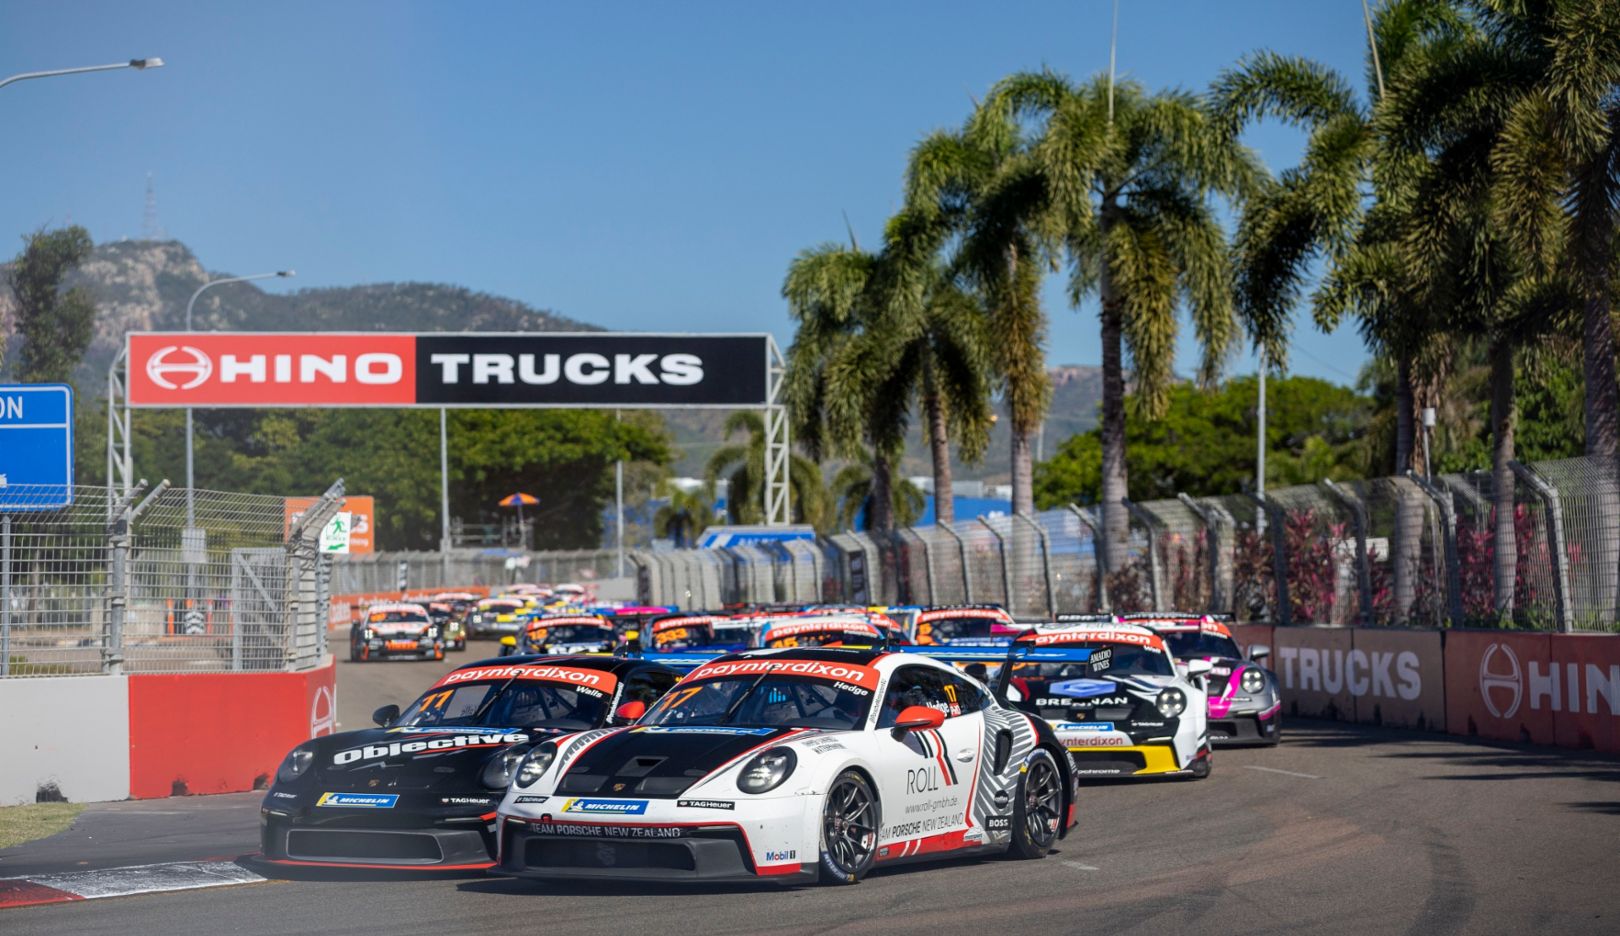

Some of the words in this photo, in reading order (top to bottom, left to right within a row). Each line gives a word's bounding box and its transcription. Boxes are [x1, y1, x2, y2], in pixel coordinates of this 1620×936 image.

[220, 352, 403, 385] HINO
[430, 353, 705, 386] TRUCKS
[1034, 631, 1151, 644] aynterdixon
[1090, 649, 1112, 664] AMADIO
[693, 660, 865, 682] paynterdixon
[1092, 661, 1110, 672] WINES
[1279, 646, 1421, 700] TRUCKS
[443, 666, 601, 685] paynterdixon
[576, 685, 604, 698] Walls
[833, 681, 869, 696] Hedge
[943, 684, 958, 703] 17
[1528, 660, 1620, 716] HIN
[419, 690, 454, 712] 11
[659, 686, 703, 712] 17
[1059, 736, 1123, 747] ynterdixon
[906, 765, 939, 795] ROLL
[585, 803, 640, 811] MICHELIN
[530, 823, 554, 835] TEAM
[556, 824, 601, 837] PORSCHE
[604, 826, 629, 837] NEW
[631, 827, 681, 838] ZEALAND
[891, 820, 921, 838] PORSCHE
[922, 816, 937, 831] NEW
[937, 811, 964, 830] ZEALAND
[988, 819, 1009, 828] BOSS
[766, 850, 788, 861] Mobil
